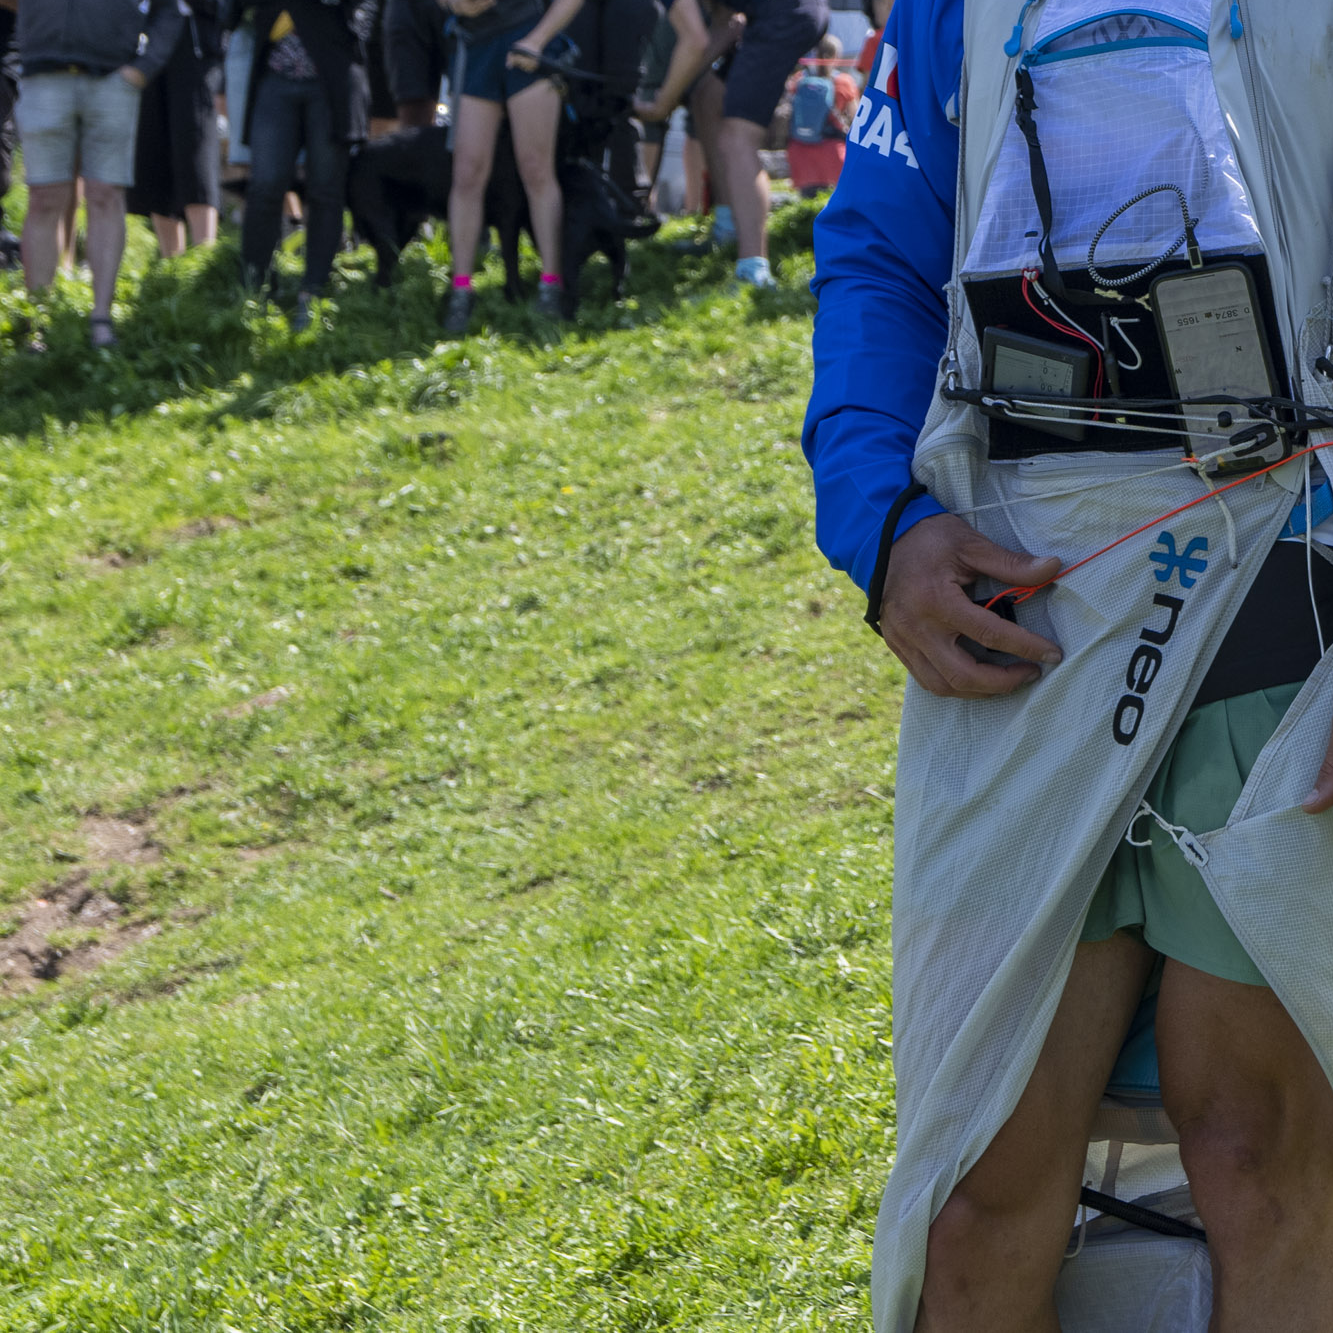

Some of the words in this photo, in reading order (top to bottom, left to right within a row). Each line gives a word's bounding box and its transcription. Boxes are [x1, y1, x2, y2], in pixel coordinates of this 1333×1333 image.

[848, 94, 920, 170] RA4
[1176, 316, 1200, 327] 1655
[1214, 309, 1239, 321] 3874
[1112, 592, 1185, 746] neo
